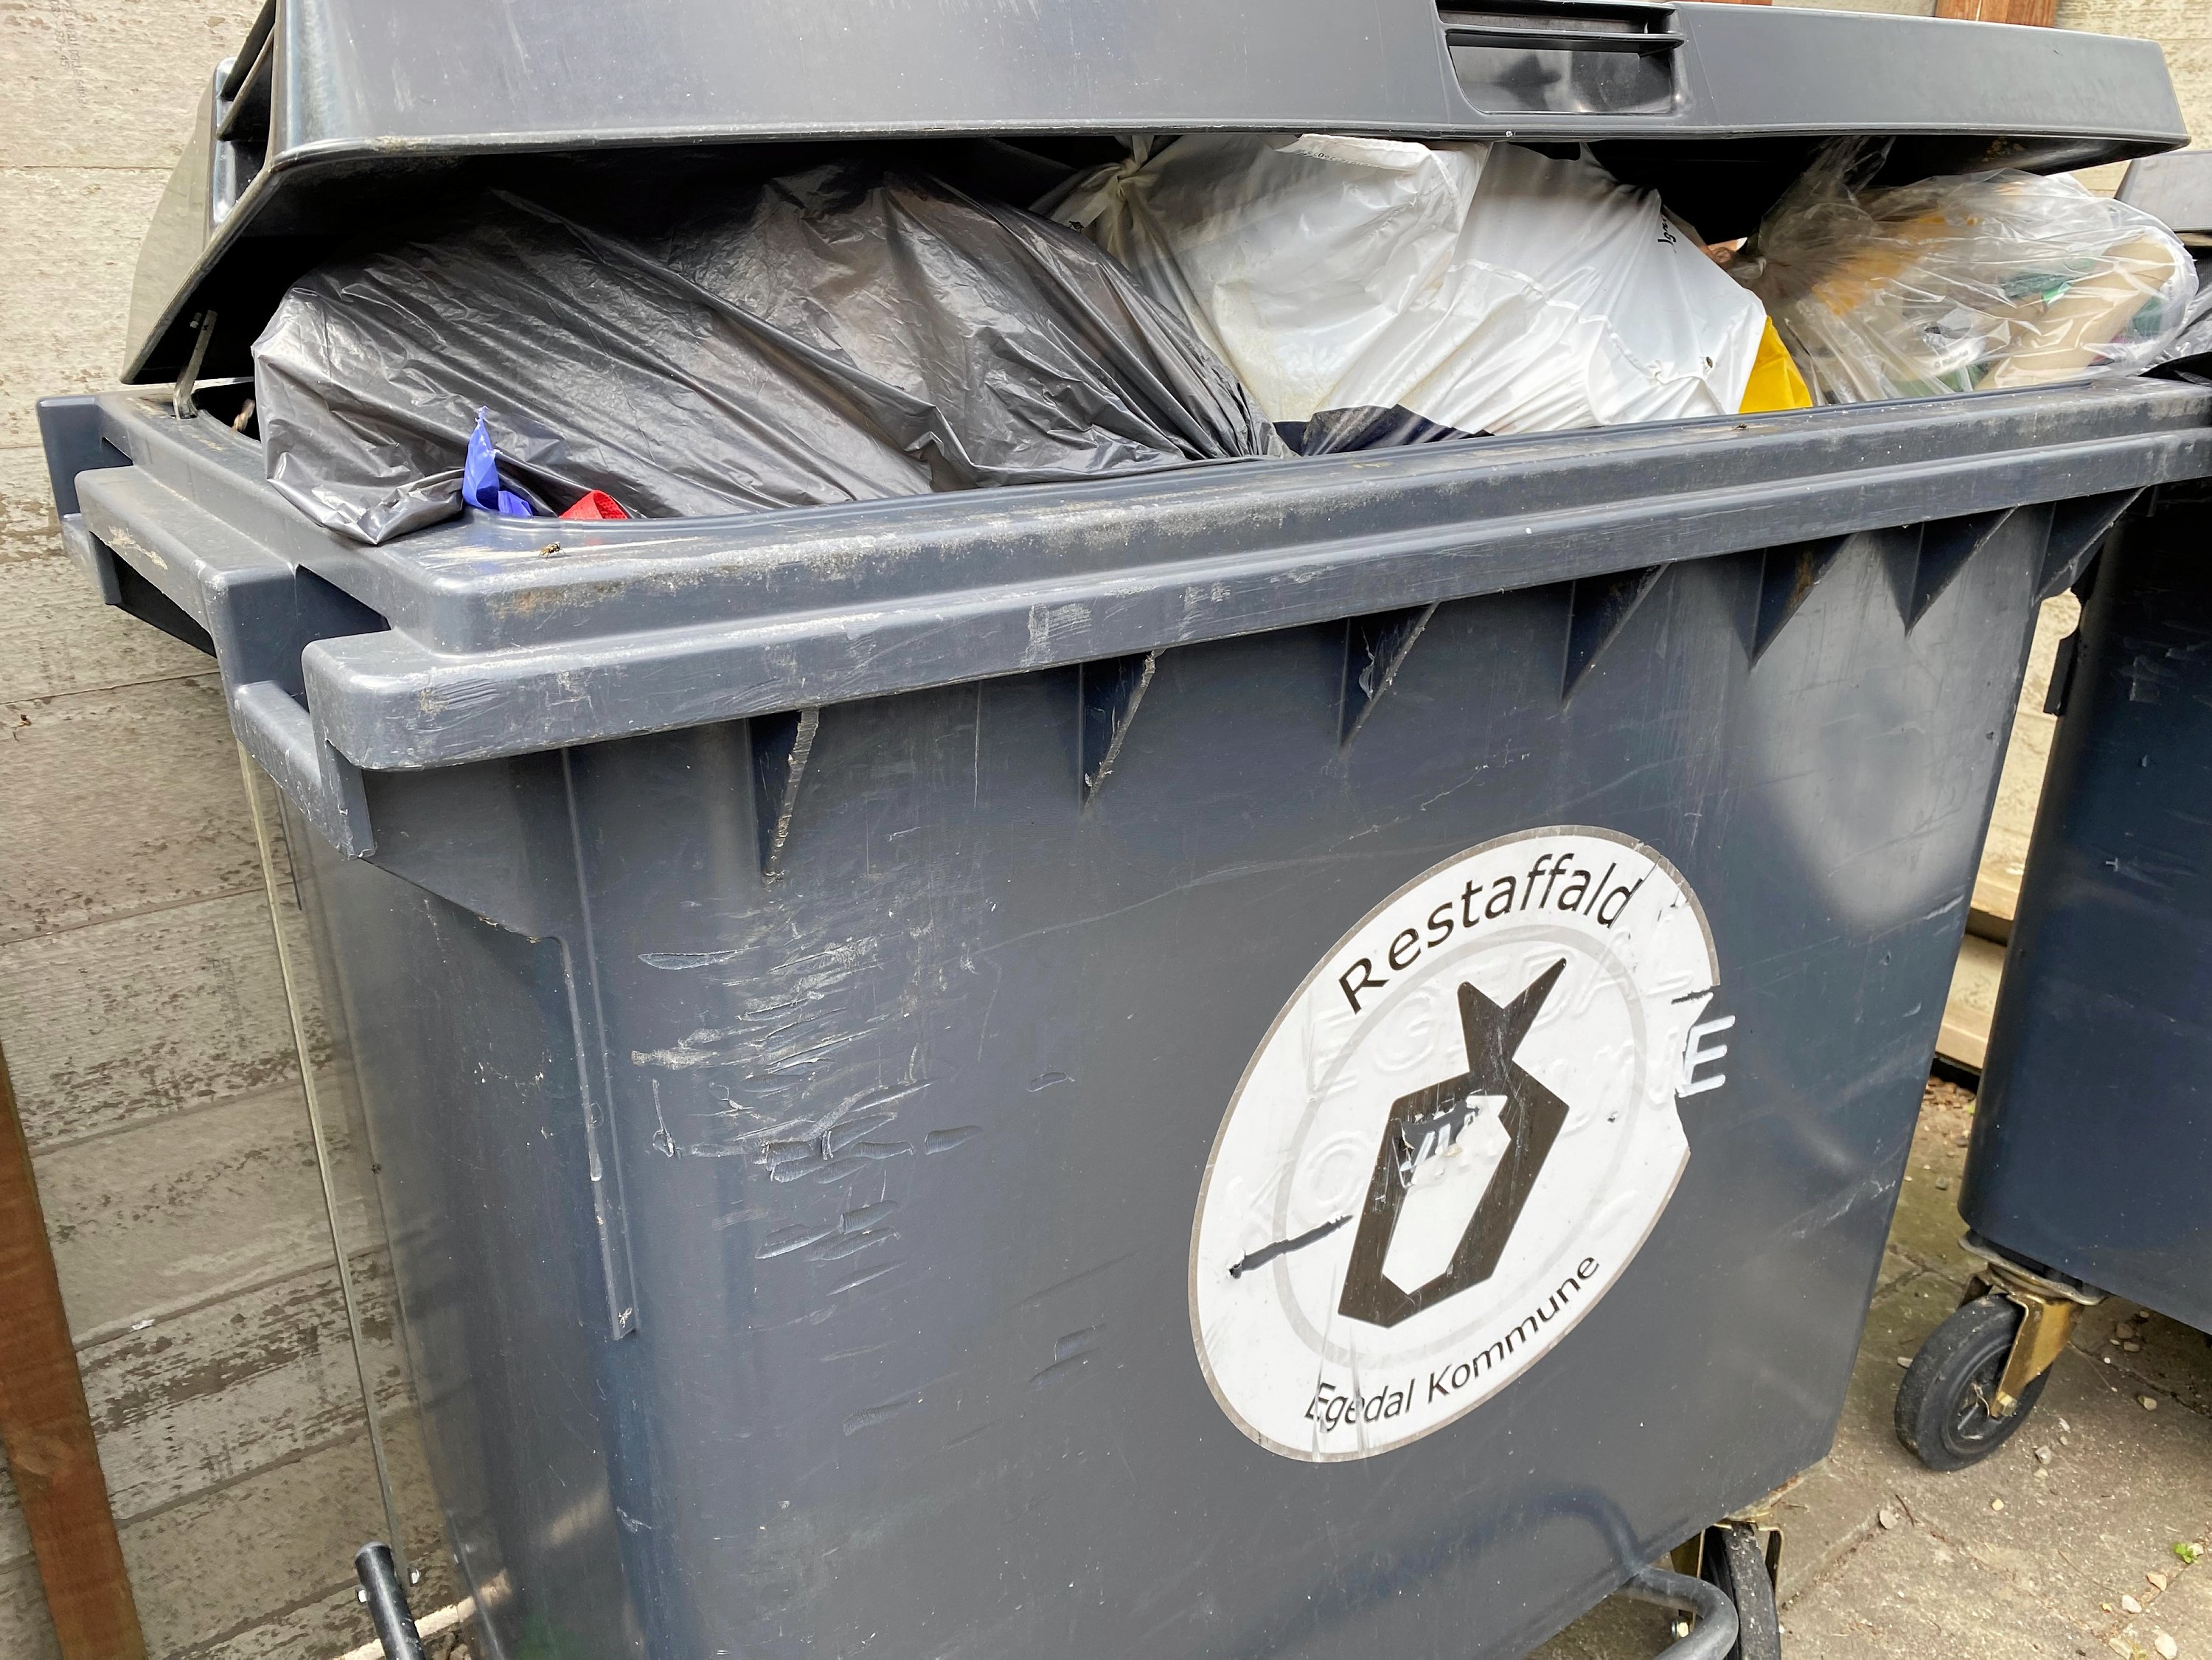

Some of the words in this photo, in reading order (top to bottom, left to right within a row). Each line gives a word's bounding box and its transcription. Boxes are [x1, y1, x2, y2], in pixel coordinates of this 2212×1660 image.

[1338, 853, 1643, 1014] Restaffald
[1304, 1379, 1416, 1432] Egedal
[1428, 1257, 1600, 1403] Kommune
